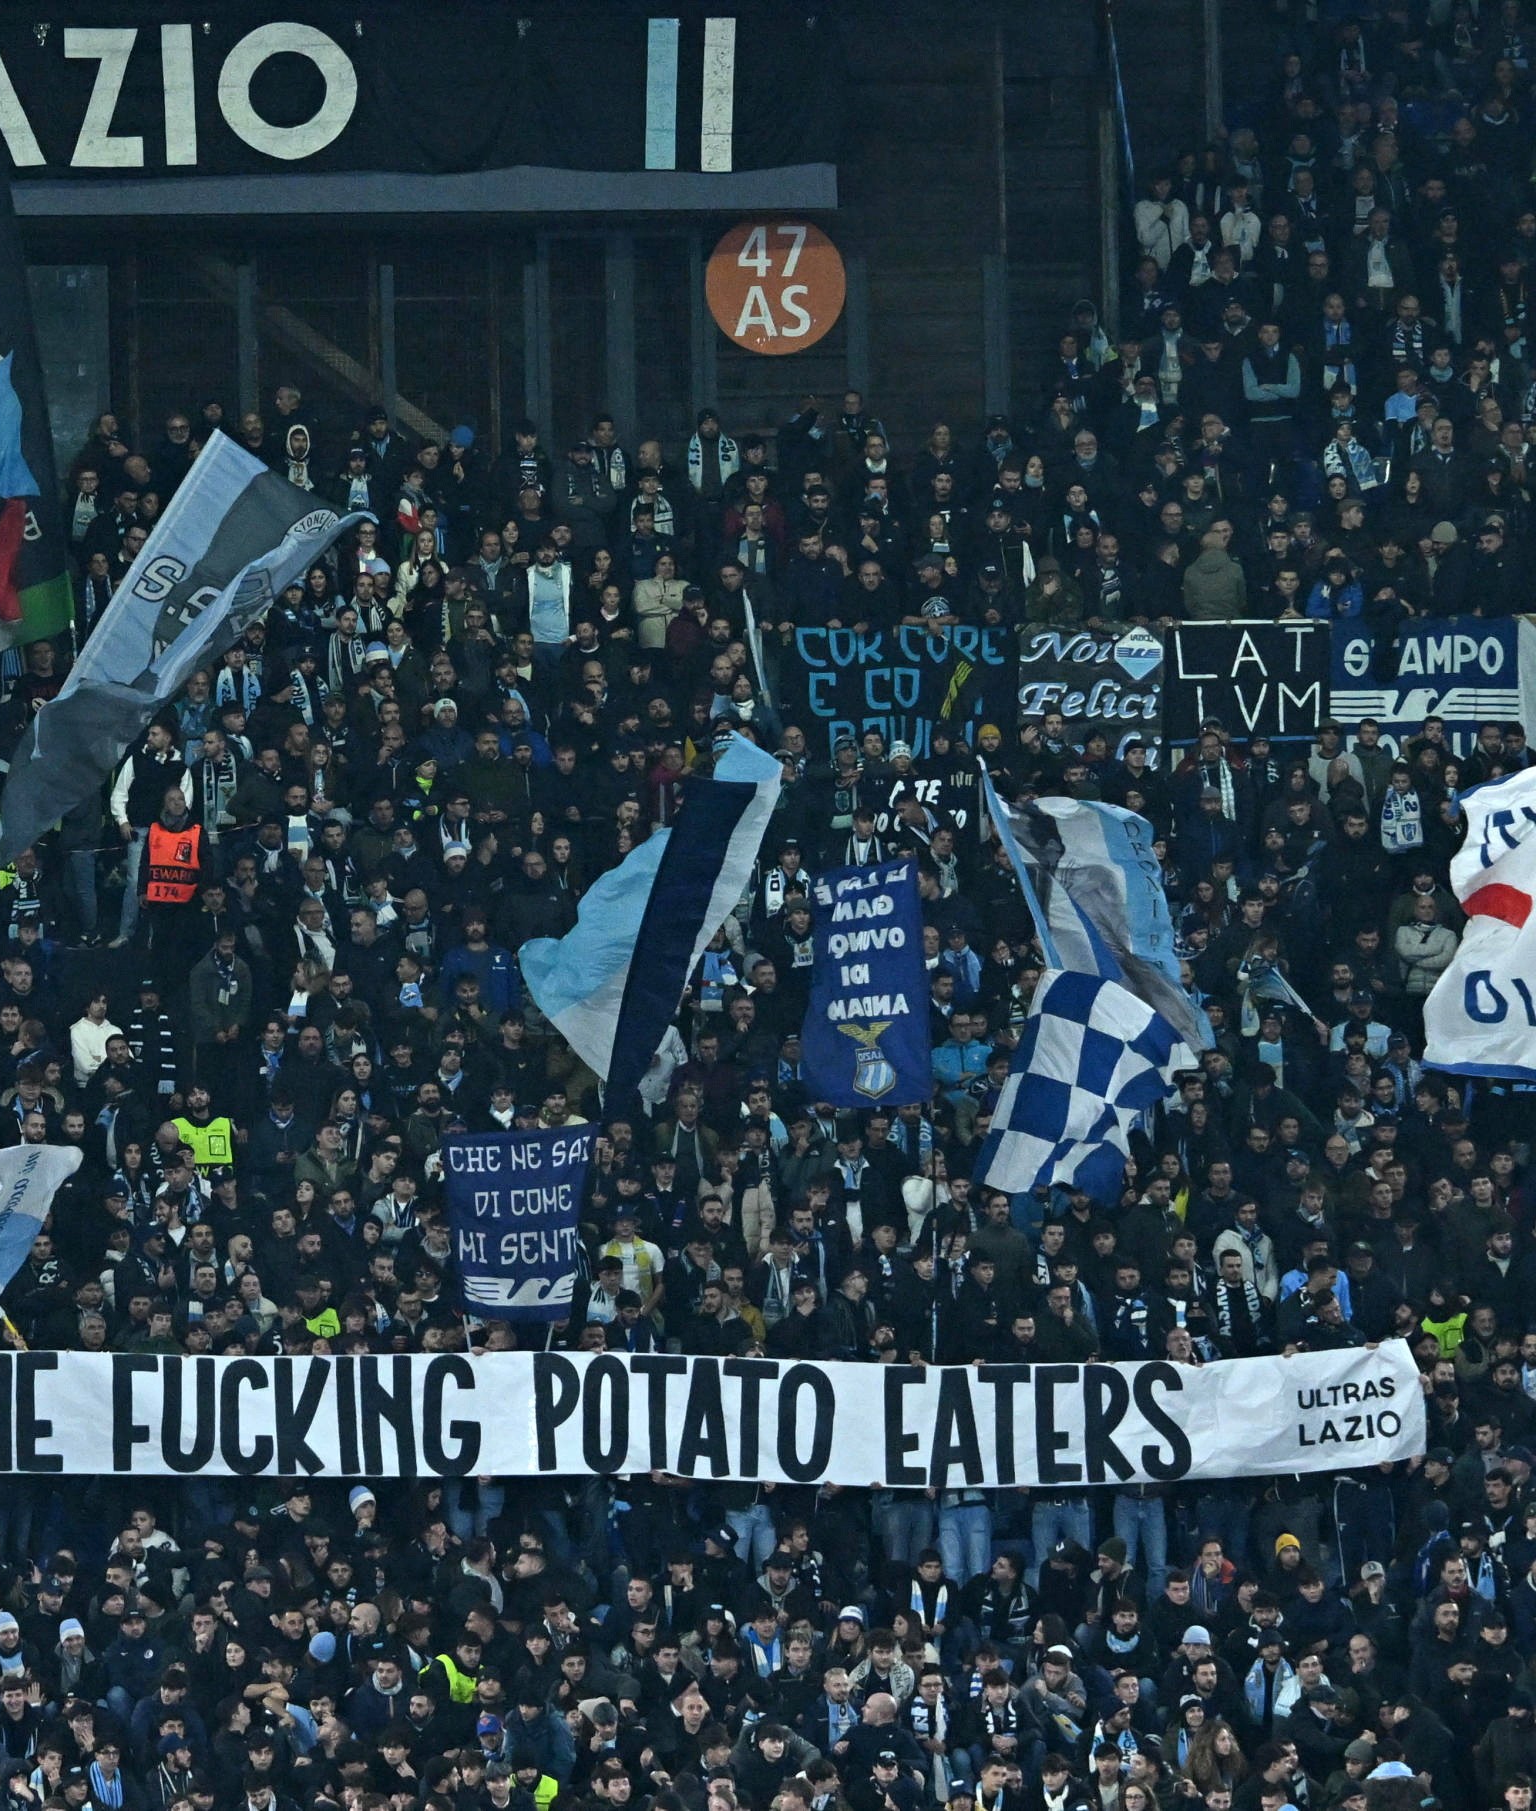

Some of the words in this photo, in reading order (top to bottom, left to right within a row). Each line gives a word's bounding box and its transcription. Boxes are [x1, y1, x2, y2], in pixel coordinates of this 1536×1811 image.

[738, 226, 806, 277] 47
[734, 285, 810, 337] AS
[1020, 632, 1119, 663] Noi
[1175, 627, 1314, 679] LAT
[1344, 635, 1504, 676] SAMPO
[809, 672, 837, 717] E
[1018, 679, 1161, 719] Felici
[154, 886, 179, 898] 174
[449, 1146, 500, 1172] CHE
[511, 1142, 541, 1171] NE
[552, 1136, 590, 1167] SAI
[475, 1191, 500, 1217] DI
[511, 1184, 572, 1216] COME
[459, 1229, 488, 1263] MI
[1297, 1377, 1395, 1409] ULTRAS
[112, 1353, 481, 1477] FUCKING
[534, 1353, 834, 1482] POTATO
[885, 1361, 1192, 1486] EATERS
[1298, 1410, 1401, 1446] LAZIO
